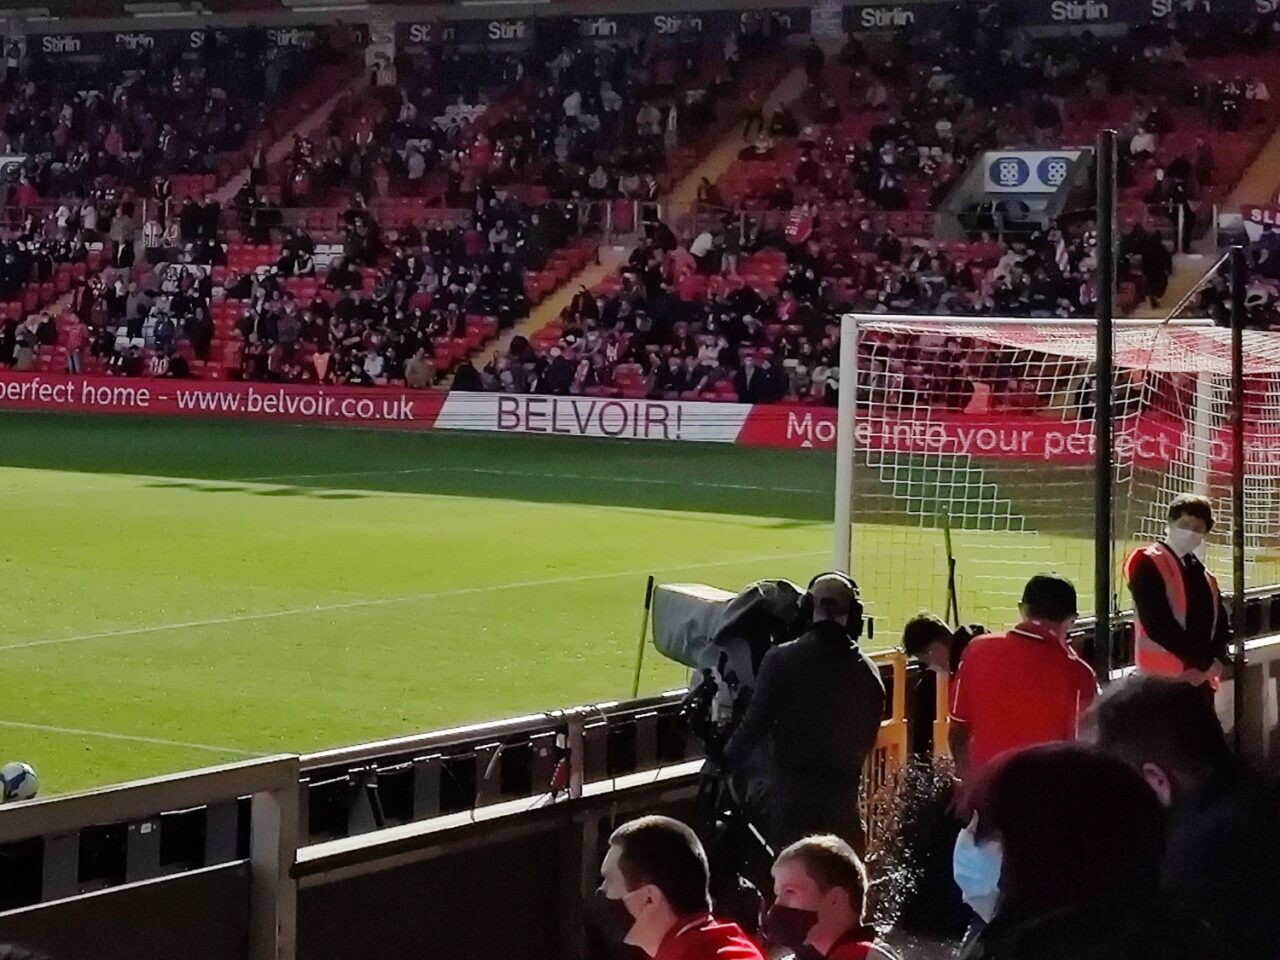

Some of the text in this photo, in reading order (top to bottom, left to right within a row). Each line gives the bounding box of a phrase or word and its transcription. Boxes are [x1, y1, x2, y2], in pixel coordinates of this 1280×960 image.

[861, 7, 914, 27] Stirlin
[1051, 0, 1108, 20] Stirlin
[81, 379, 150, 406] home
[176, 388, 414, 421] www.belvoir.co.uk
[496, 396, 683, 440] BELVOIR!
[786, 411, 871, 444] Moe
[956, 426, 1033, 455] your
